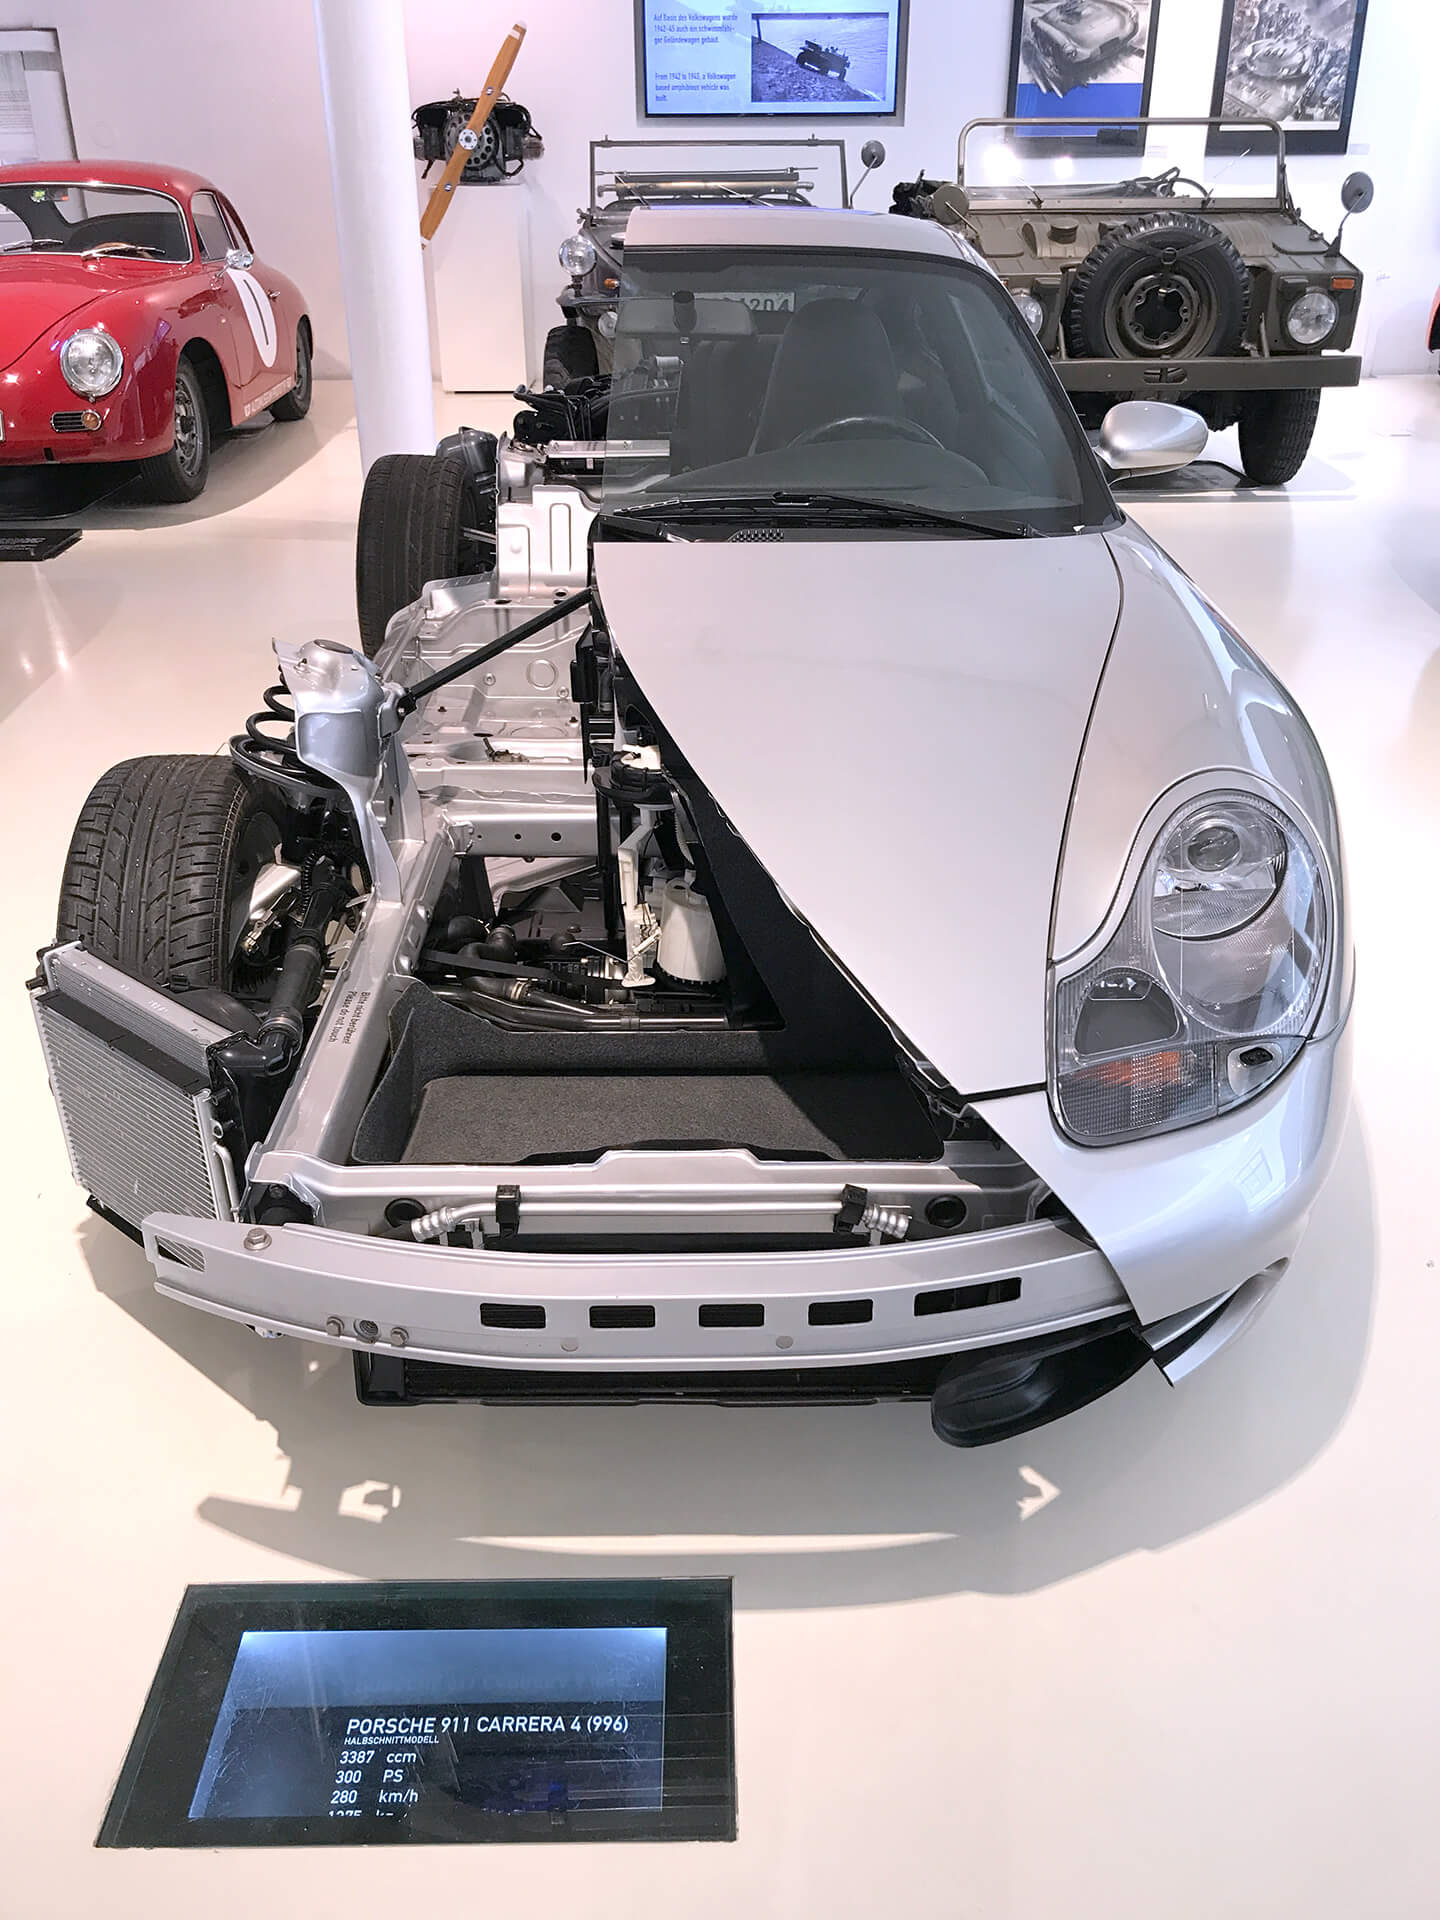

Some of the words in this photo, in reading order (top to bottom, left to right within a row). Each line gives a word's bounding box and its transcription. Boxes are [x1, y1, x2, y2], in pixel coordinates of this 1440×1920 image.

[342, 990, 358, 1009] Please
[358, 991, 371, 1005] Bitte
[352, 1004, 364, 1019] nicht
[328, 1025, 342, 1043] touch
[347, 1717, 437, 1735] PORSCHE
[441, 1717, 470, 1733] 911
[476, 1716, 566, 1733] CARRERA
[570, 1716, 581, 1732] 4
[587, 1715, 629, 1733] (996)
[344, 1735, 440, 1745] HALBSCHNITTMODELL
[339, 1750, 375, 1764] 3387
[386, 1752, 417, 1763] ccm
[335, 1770, 362, 1784] 300
[382, 1769, 404, 1783] PS
[330, 1790, 358, 1804] 280
[378, 1789, 419, 1803] km/h
